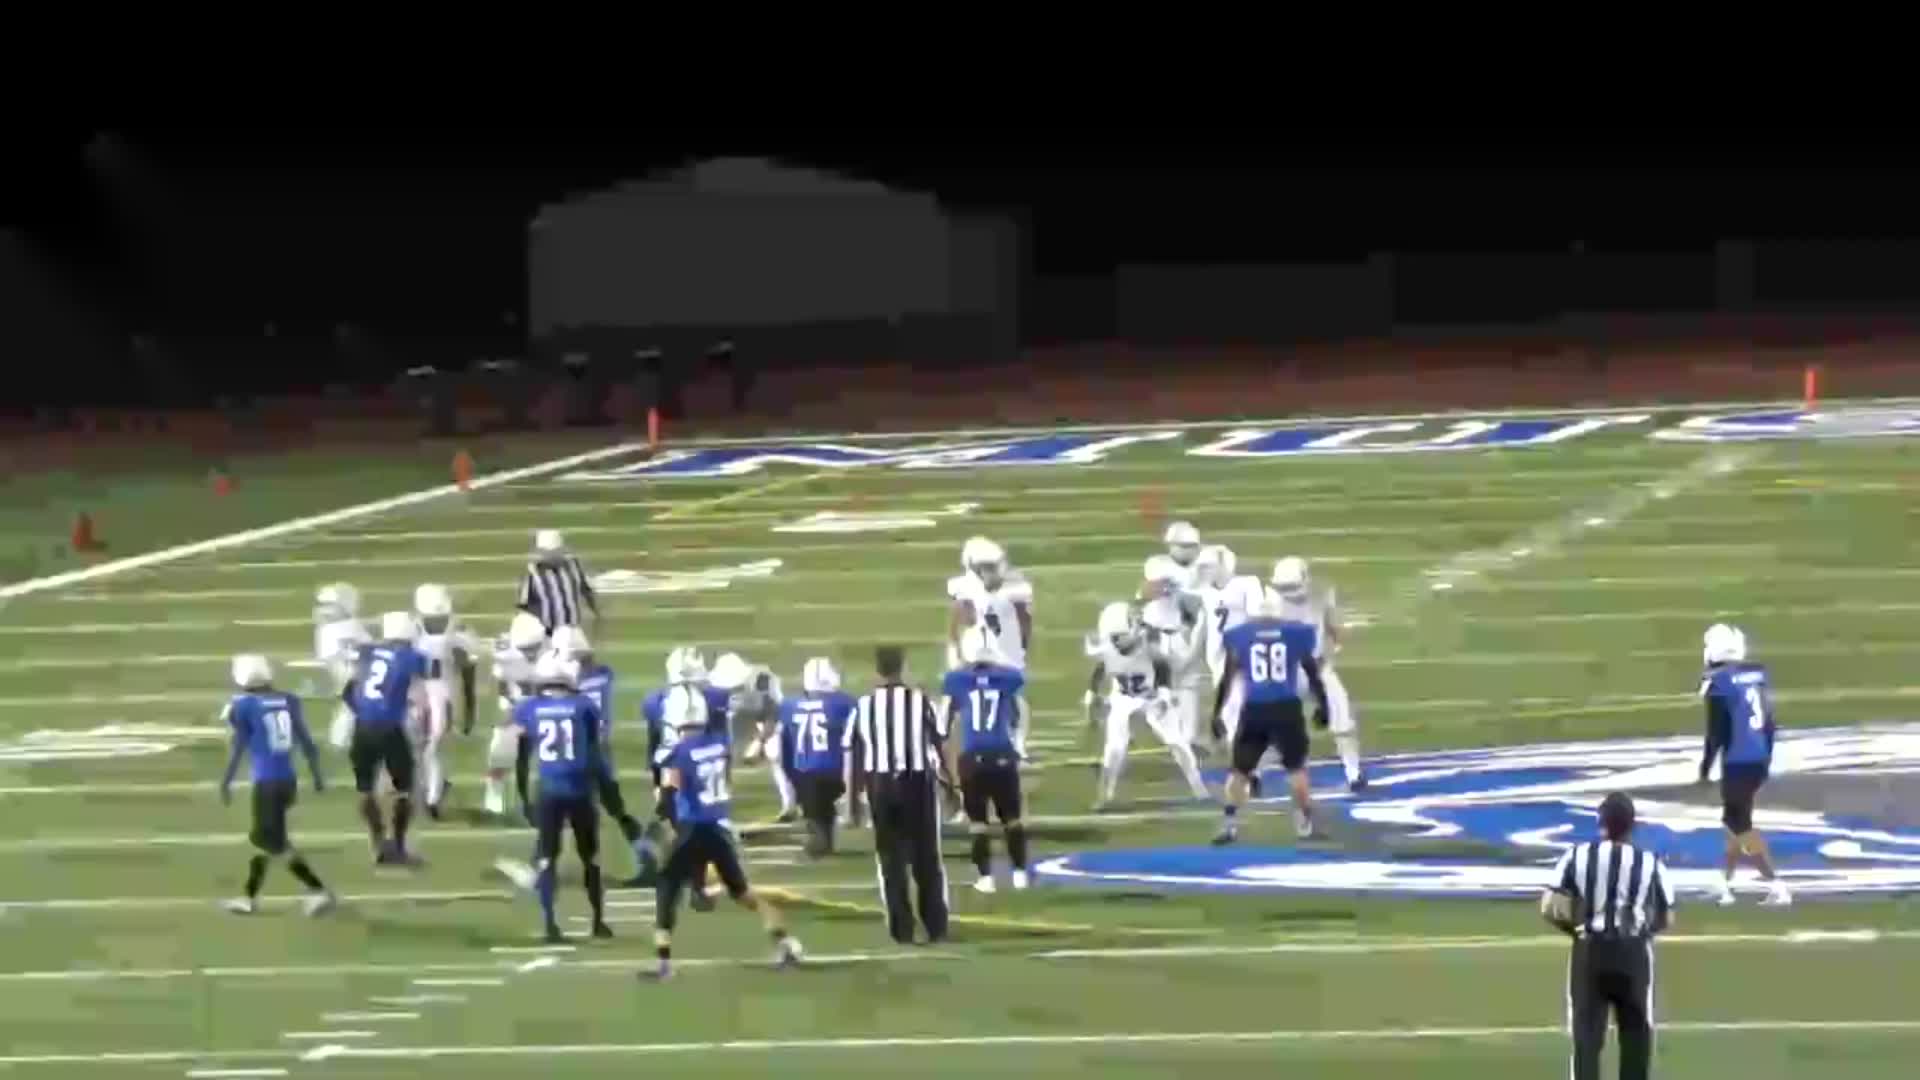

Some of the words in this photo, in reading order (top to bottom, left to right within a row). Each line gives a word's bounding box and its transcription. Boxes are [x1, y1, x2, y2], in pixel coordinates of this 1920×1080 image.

[364, 659, 388, 699] 2
[1250, 642, 1287, 682] 68
[968, 689, 1001, 731] 17
[1745, 687, 1762, 730] 3
[538, 719, 575, 761] 21
[792, 712, 828, 751] 76
